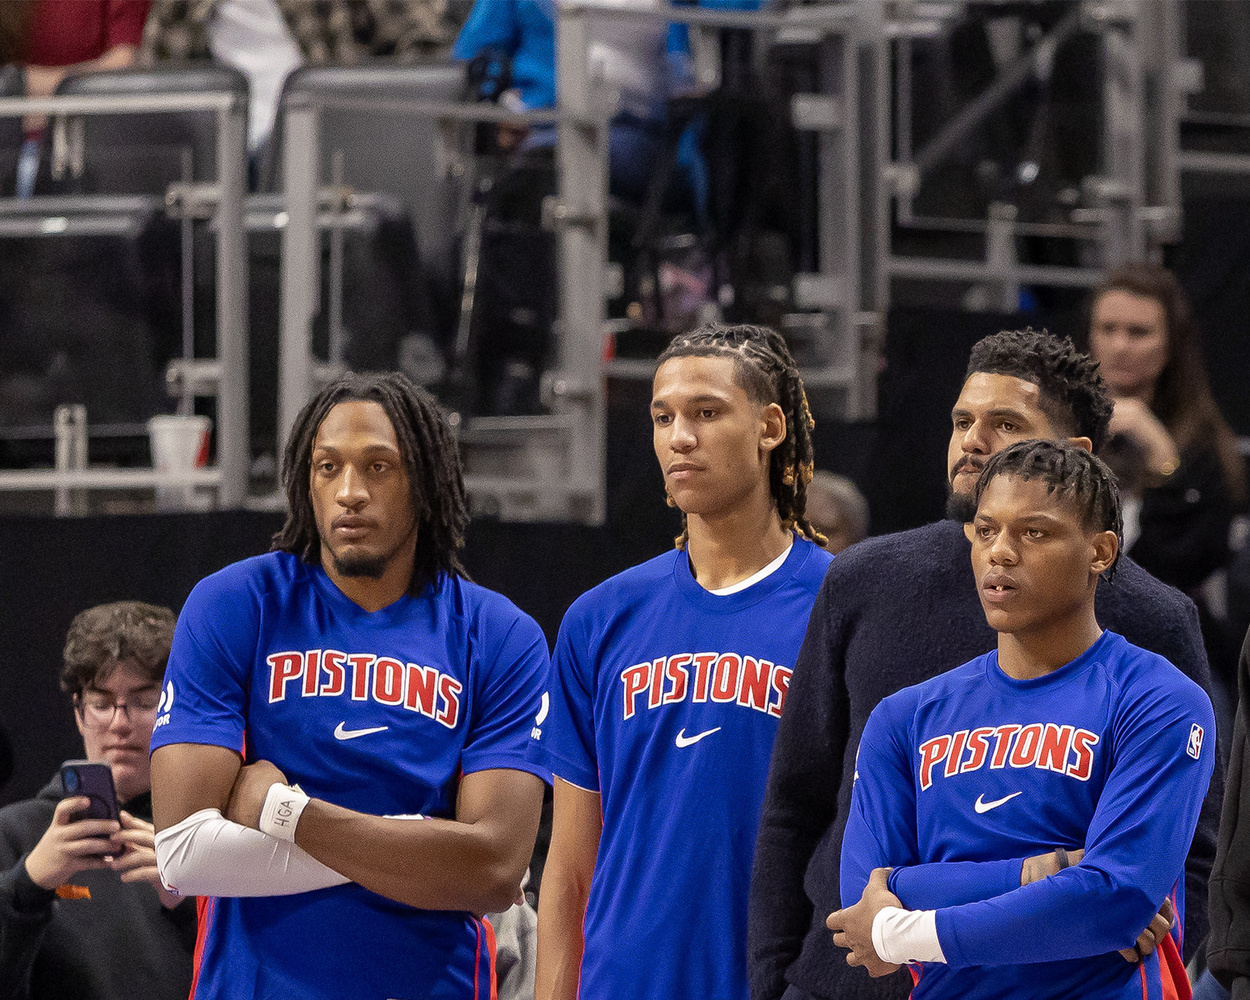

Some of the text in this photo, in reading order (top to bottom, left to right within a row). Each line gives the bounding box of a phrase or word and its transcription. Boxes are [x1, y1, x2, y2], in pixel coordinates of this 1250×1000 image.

[266, 649, 463, 729] PISTONS
[620, 652, 793, 721] PISTONS
[919, 723, 1100, 792] PISTONS
[274, 800, 297, 828] HGA
